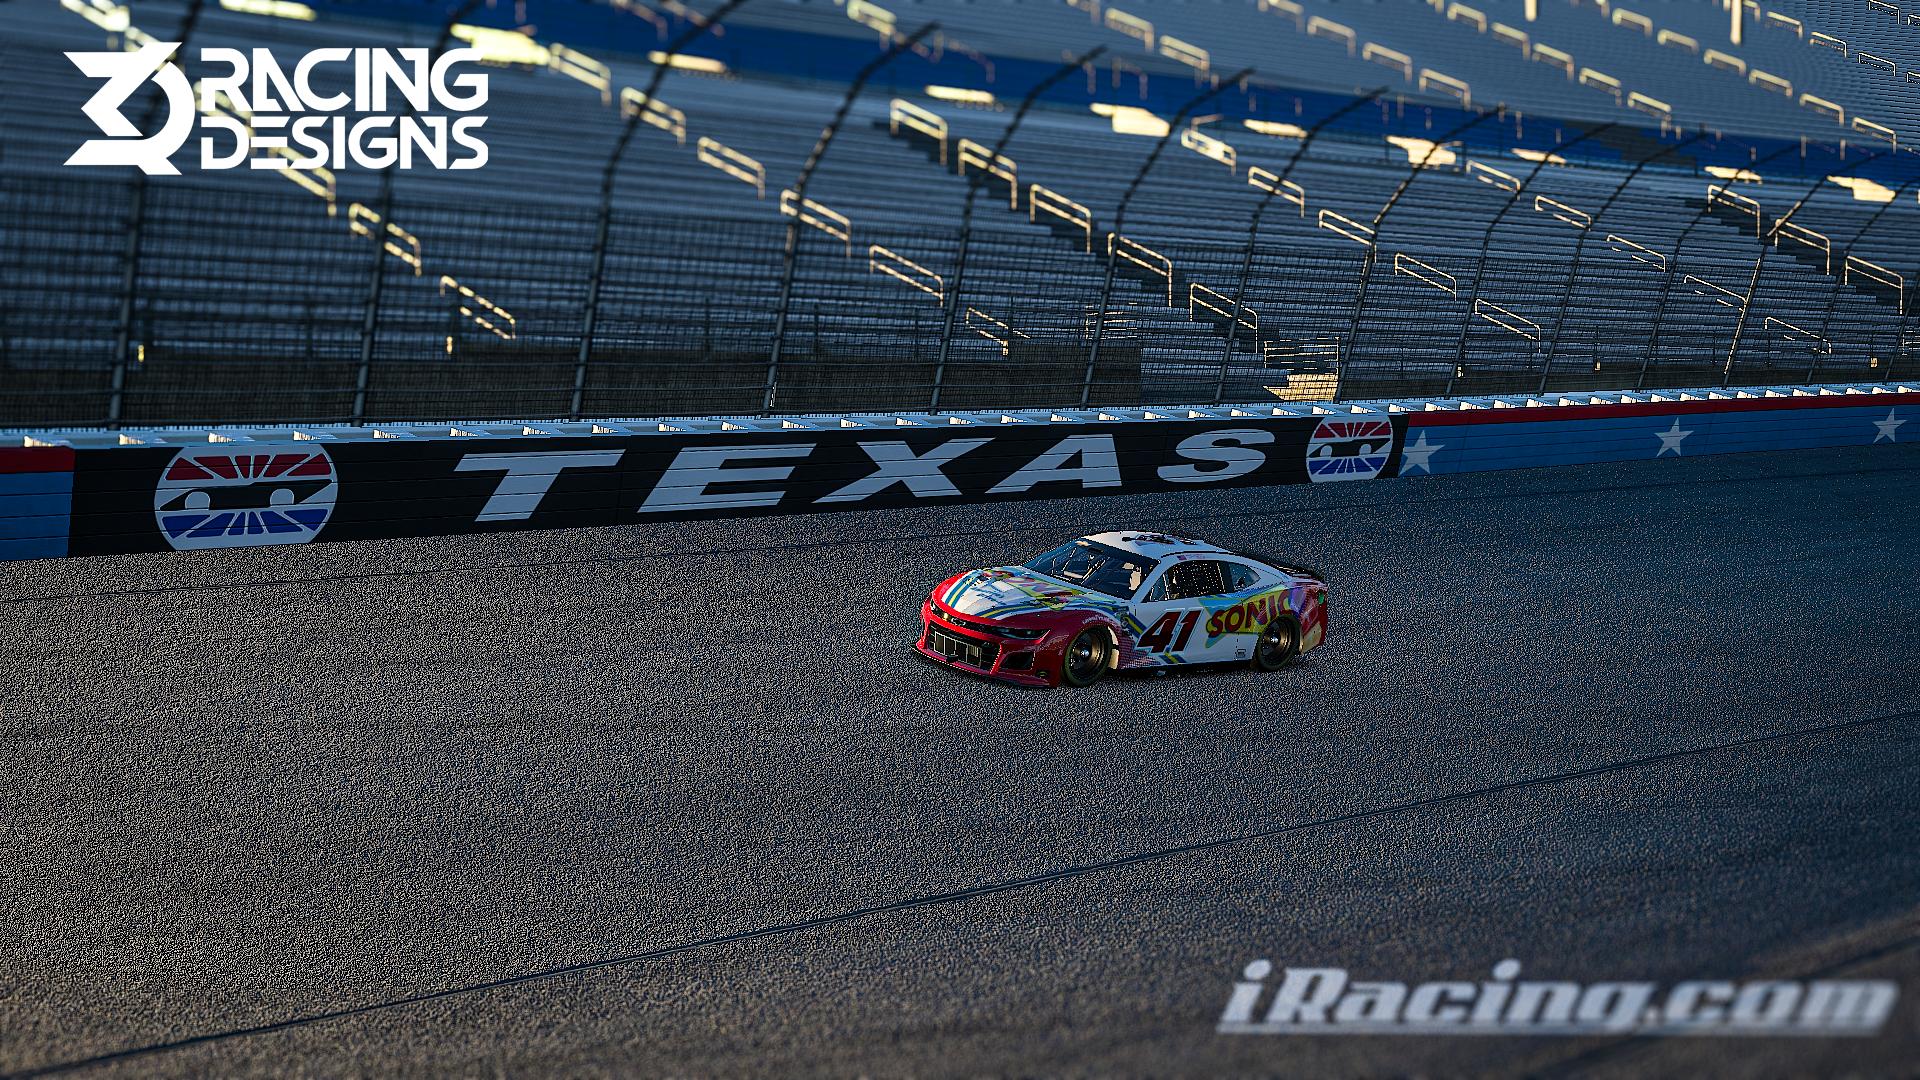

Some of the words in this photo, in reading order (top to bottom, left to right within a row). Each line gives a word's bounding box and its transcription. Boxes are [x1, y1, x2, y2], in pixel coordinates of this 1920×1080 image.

[454, 429, 1276, 522] TEXAS
[1137, 609, 1202, 653] 41
[1208, 590, 1293, 638] SONIC
